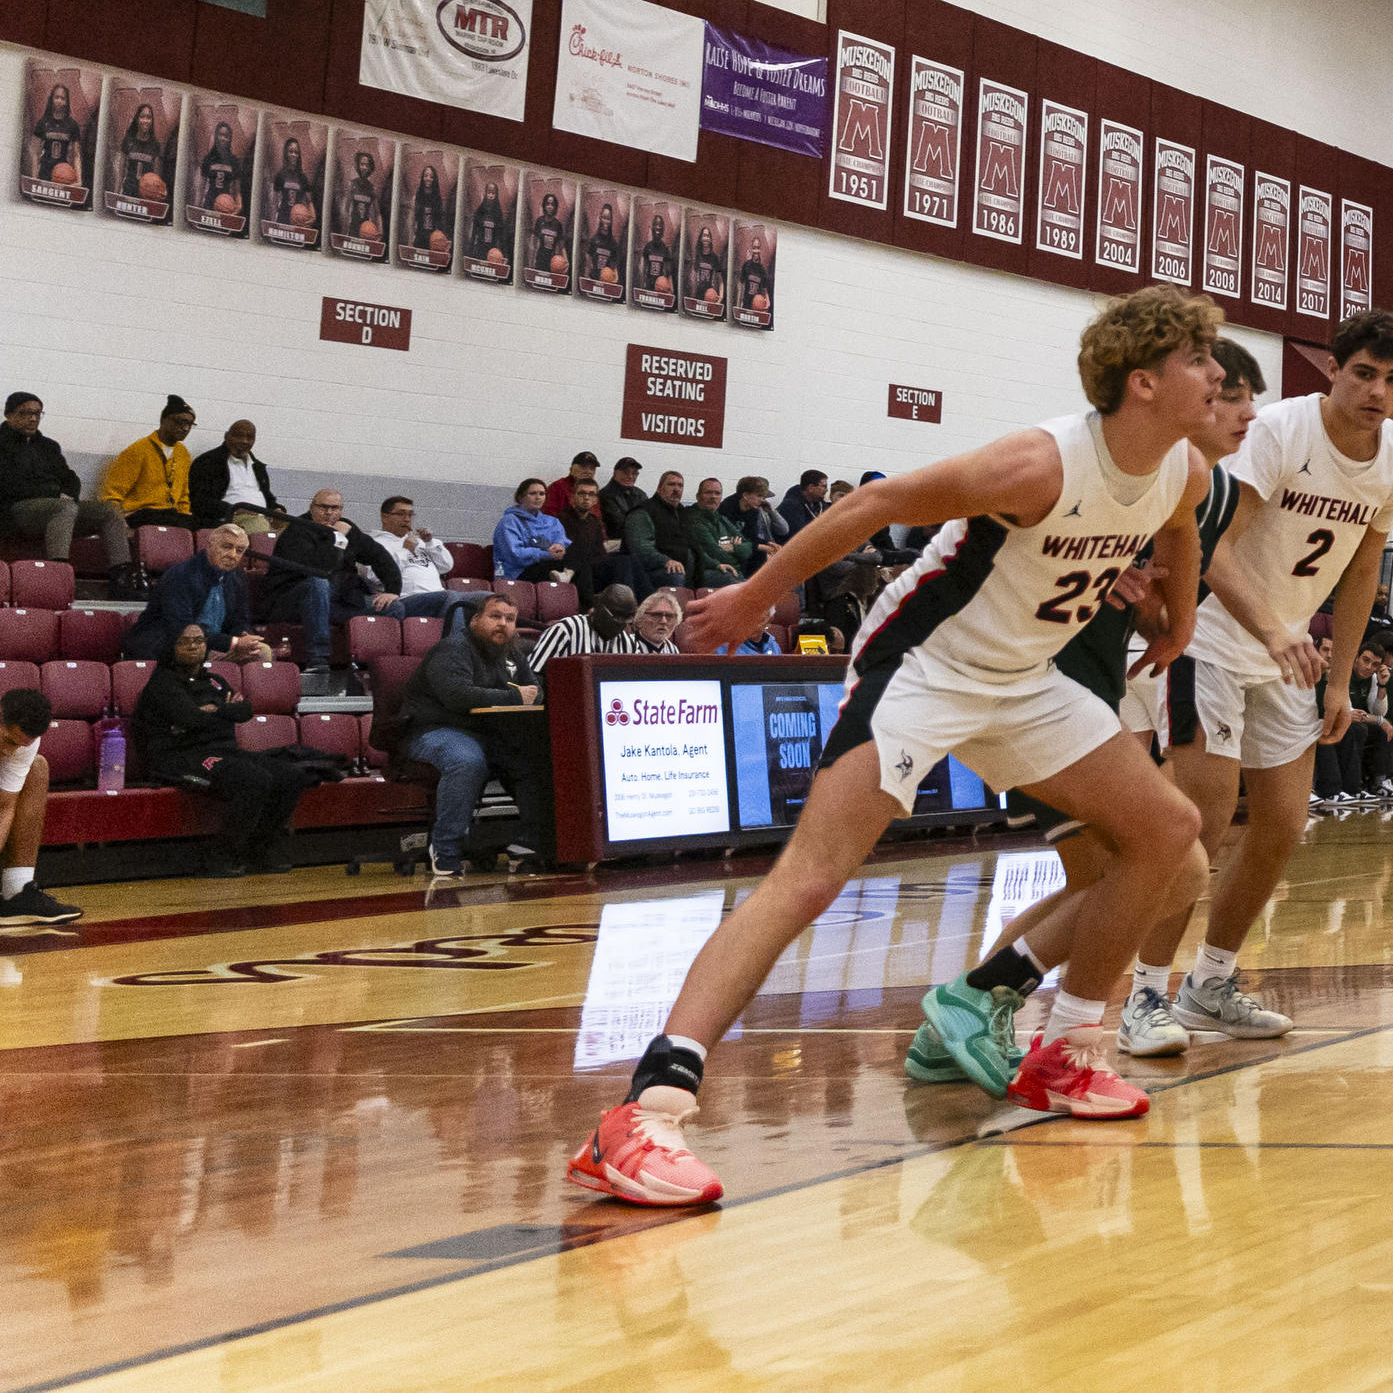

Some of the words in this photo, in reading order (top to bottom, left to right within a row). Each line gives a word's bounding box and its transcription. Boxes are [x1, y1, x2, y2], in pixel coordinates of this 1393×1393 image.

[454, 4, 509, 41] MTR
[840, 45, 891, 83] MUSKEGON
[793, 68, 826, 97] DREAMS
[914, 70, 960, 105] MUSKEGON
[982, 92, 1024, 126] MUSKEGON
[1045, 112, 1085, 146] MUSKEGON
[1103, 132, 1142, 164] MUSKEGON
[1158, 150, 1193, 180] MUSKEGON
[31, 183, 71, 200] SARGENT
[841, 171, 877, 200] 1951
[1209, 166, 1242, 196] MUSKEGON
[116, 200, 149, 215] HUNTER
[914, 192, 948, 218] 1971
[1257, 182, 1288, 210] MUSKEGON
[200, 214, 222, 228] EZELL
[982, 209, 1015, 236] 1986
[268, 227, 305, 242] HAMILTON
[1045, 226, 1076, 250] 1989
[1103, 241, 1132, 265] 2004
[1158, 256, 1185, 278] 2006
[1209, 268, 1235, 291] 2008
[1257, 282, 1282, 303] 2014
[1302, 292, 1325, 312] 2017
[335, 304, 401, 329] SECTION
[361, 326, 373, 344] D
[641, 354, 713, 382] RESERVED
[646, 378, 706, 402] SEATING
[896, 387, 936, 407] SECTION
[641, 412, 706, 438] VISITORS
[911, 405, 919, 420] E
[1291, 528, 1336, 577] 2
[633, 699, 676, 726] State
[678, 698, 718, 725] Farm
[769, 712, 816, 738] COMING
[620, 745, 642, 758] Jake
[683, 743, 708, 758] Agent
[779, 742, 811, 769] SOON
[664, 771, 677, 780] Life
[678, 770, 710, 780] Insurance
